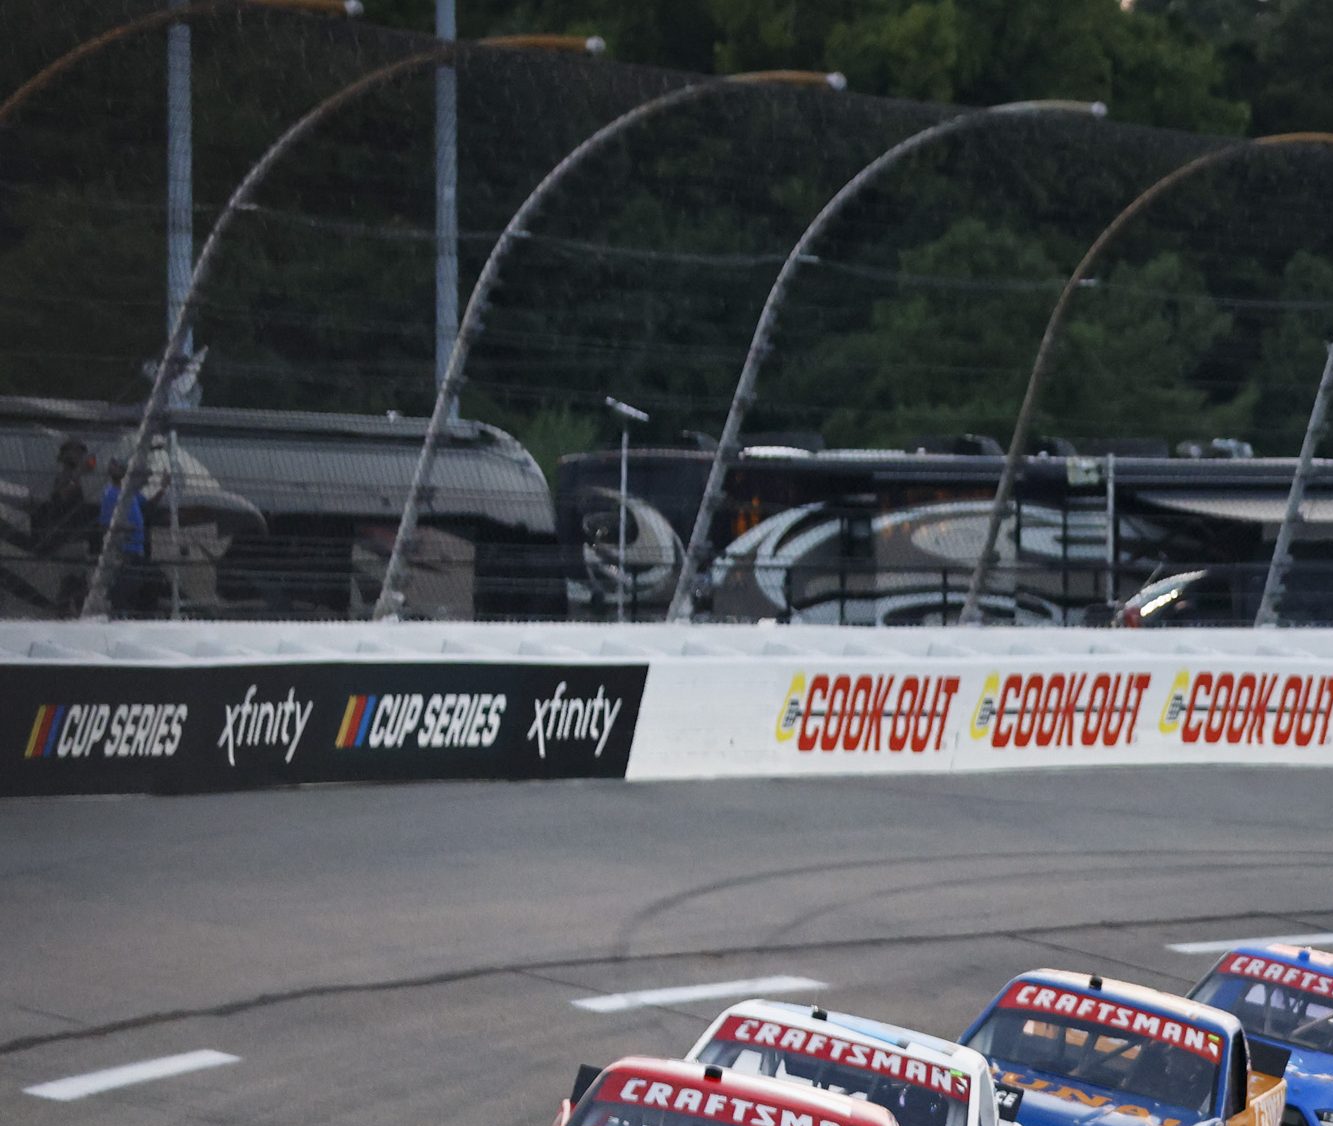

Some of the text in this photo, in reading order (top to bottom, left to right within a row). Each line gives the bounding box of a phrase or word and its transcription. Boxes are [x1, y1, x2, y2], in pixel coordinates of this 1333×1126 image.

[57, 704, 188, 757] CUP SERIES
[217, 684, 314, 766] xfinity
[369, 694, 506, 748] CUP SERIES
[526, 682, 622, 759] xfinity
[798, 674, 960, 752] COOK OUT
[991, 673, 1151, 748] COOK OUT
[1181, 672, 1278, 746] COOK
[1015, 983, 1204, 1049] CRAFTSMAN
[733, 1018, 953, 1092] CRAFTSMAN
